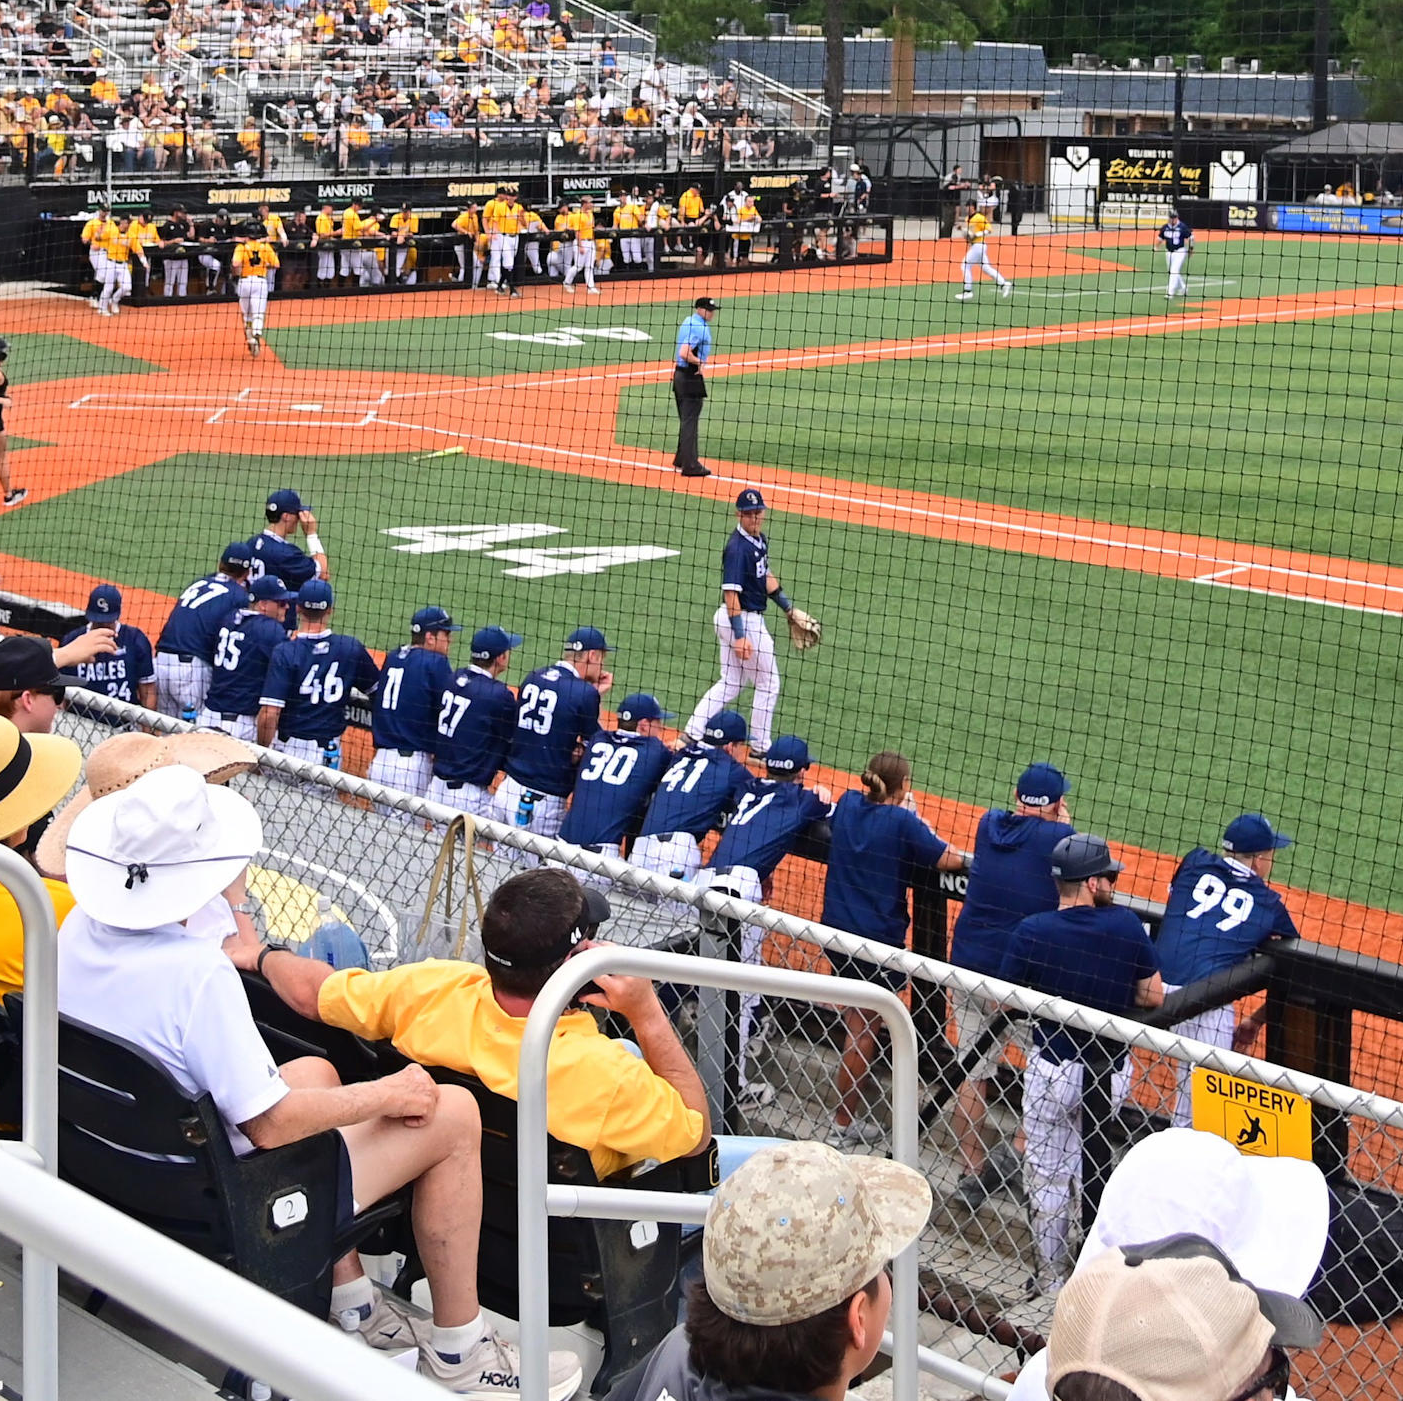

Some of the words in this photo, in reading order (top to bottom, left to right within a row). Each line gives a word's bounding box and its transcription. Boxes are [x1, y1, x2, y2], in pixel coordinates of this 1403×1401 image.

[87, 188, 152, 203] BANKFIRST
[318, 184, 375, 197] BANKFIRST
[563, 177, 612, 190] BANKFIRST
[180, 579, 229, 610] 47
[214, 627, 245, 671] 35
[77, 660, 127, 682] EAGLES
[299, 661, 344, 705] 46
[382, 667, 405, 710] 11
[107, 681, 132, 701] 24
[518, 683, 558, 735] 23
[438, 689, 471, 738] 27
[581, 742, 638, 786] 30
[661, 756, 709, 793] 41
[939, 872, 969, 895] NO
[1186, 873, 1254, 932] 99
[1205, 1074, 1296, 1115] SLIPPERY
[284, 1200, 296, 1220] 2
